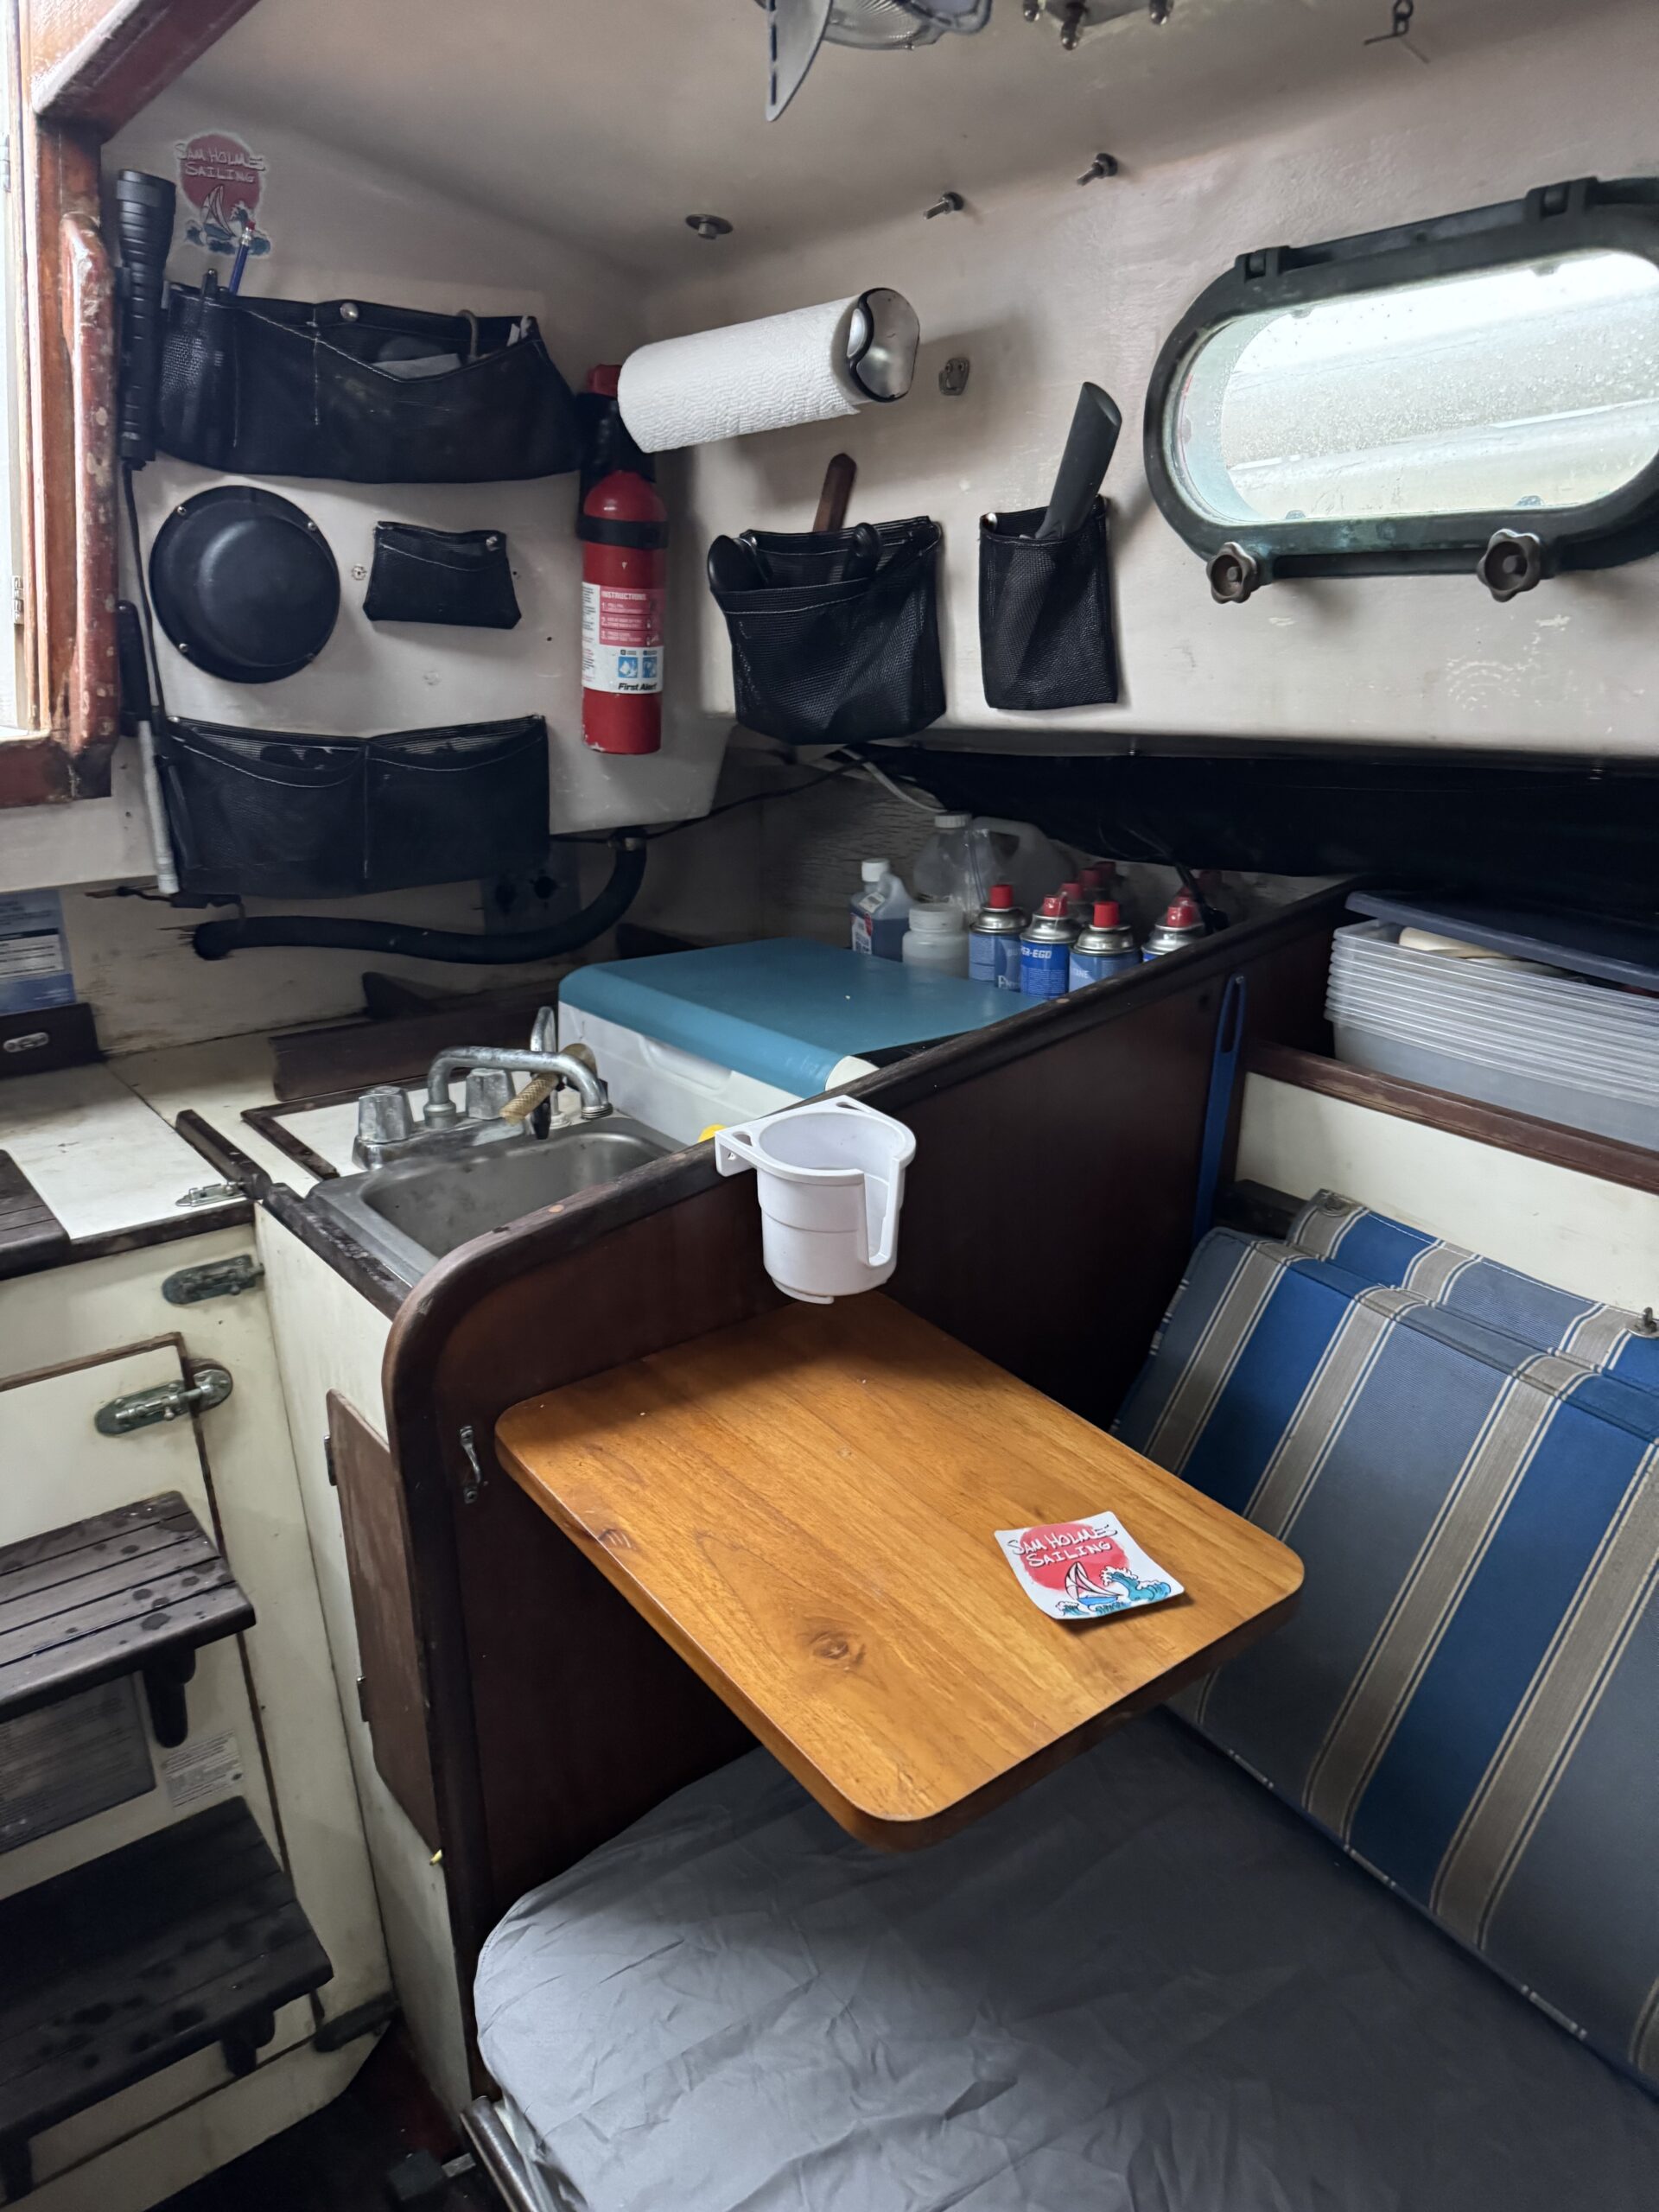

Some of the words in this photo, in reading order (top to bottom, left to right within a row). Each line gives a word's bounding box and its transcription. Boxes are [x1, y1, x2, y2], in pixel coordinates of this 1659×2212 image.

[185, 162, 256, 183] SAILING
[618, 683, 639, 691] First
[639, 683, 658, 691] Alert
[1007, 1539, 1047, 1555] SAM
[1026, 1541, 1112, 1567] SAILING
